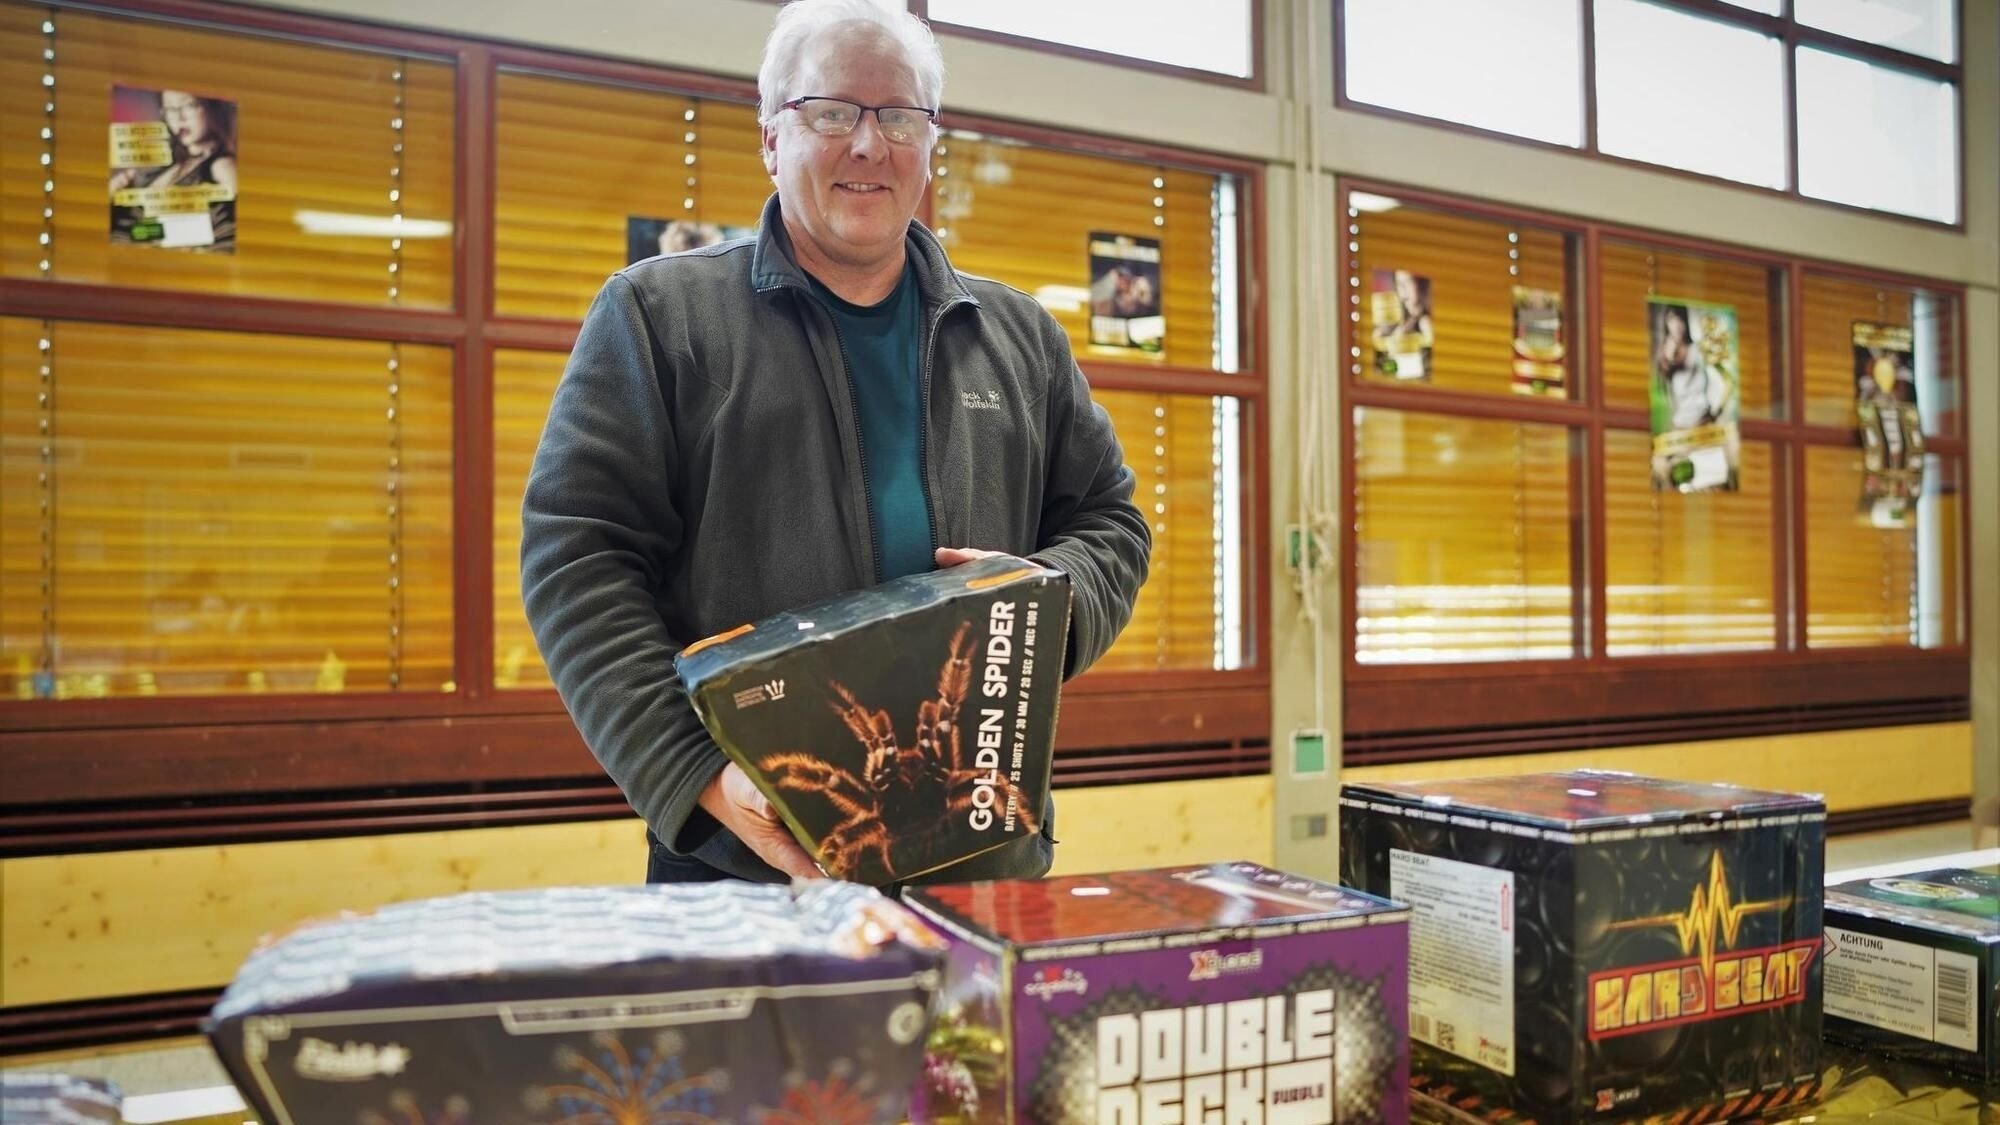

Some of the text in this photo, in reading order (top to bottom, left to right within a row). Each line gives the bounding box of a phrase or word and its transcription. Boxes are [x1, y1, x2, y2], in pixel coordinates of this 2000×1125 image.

[1024, 628, 1036, 646] NEC
[1022, 658, 1034, 675] SEC
[1020, 677, 1032, 689] 20
[969, 601, 1016, 831] GOLDEN SPIDER
[1016, 700, 1029, 717] MM
[1015, 718, 1028, 730] 30
[1011, 742, 1025, 769] SHOTS
[1010, 770, 1022, 782] 25
[1004, 794, 1018, 832] BATTERY
[1840, 933, 1884, 951] ACHTUNG
[1594, 965, 1707, 1031] HARD
[1714, 946, 1813, 1010] BEAT
[1097, 989, 1334, 1088] DOUBLE
[1099, 1068, 1266, 1125] DECK
[1272, 1083, 1325, 1105] PURPLE
